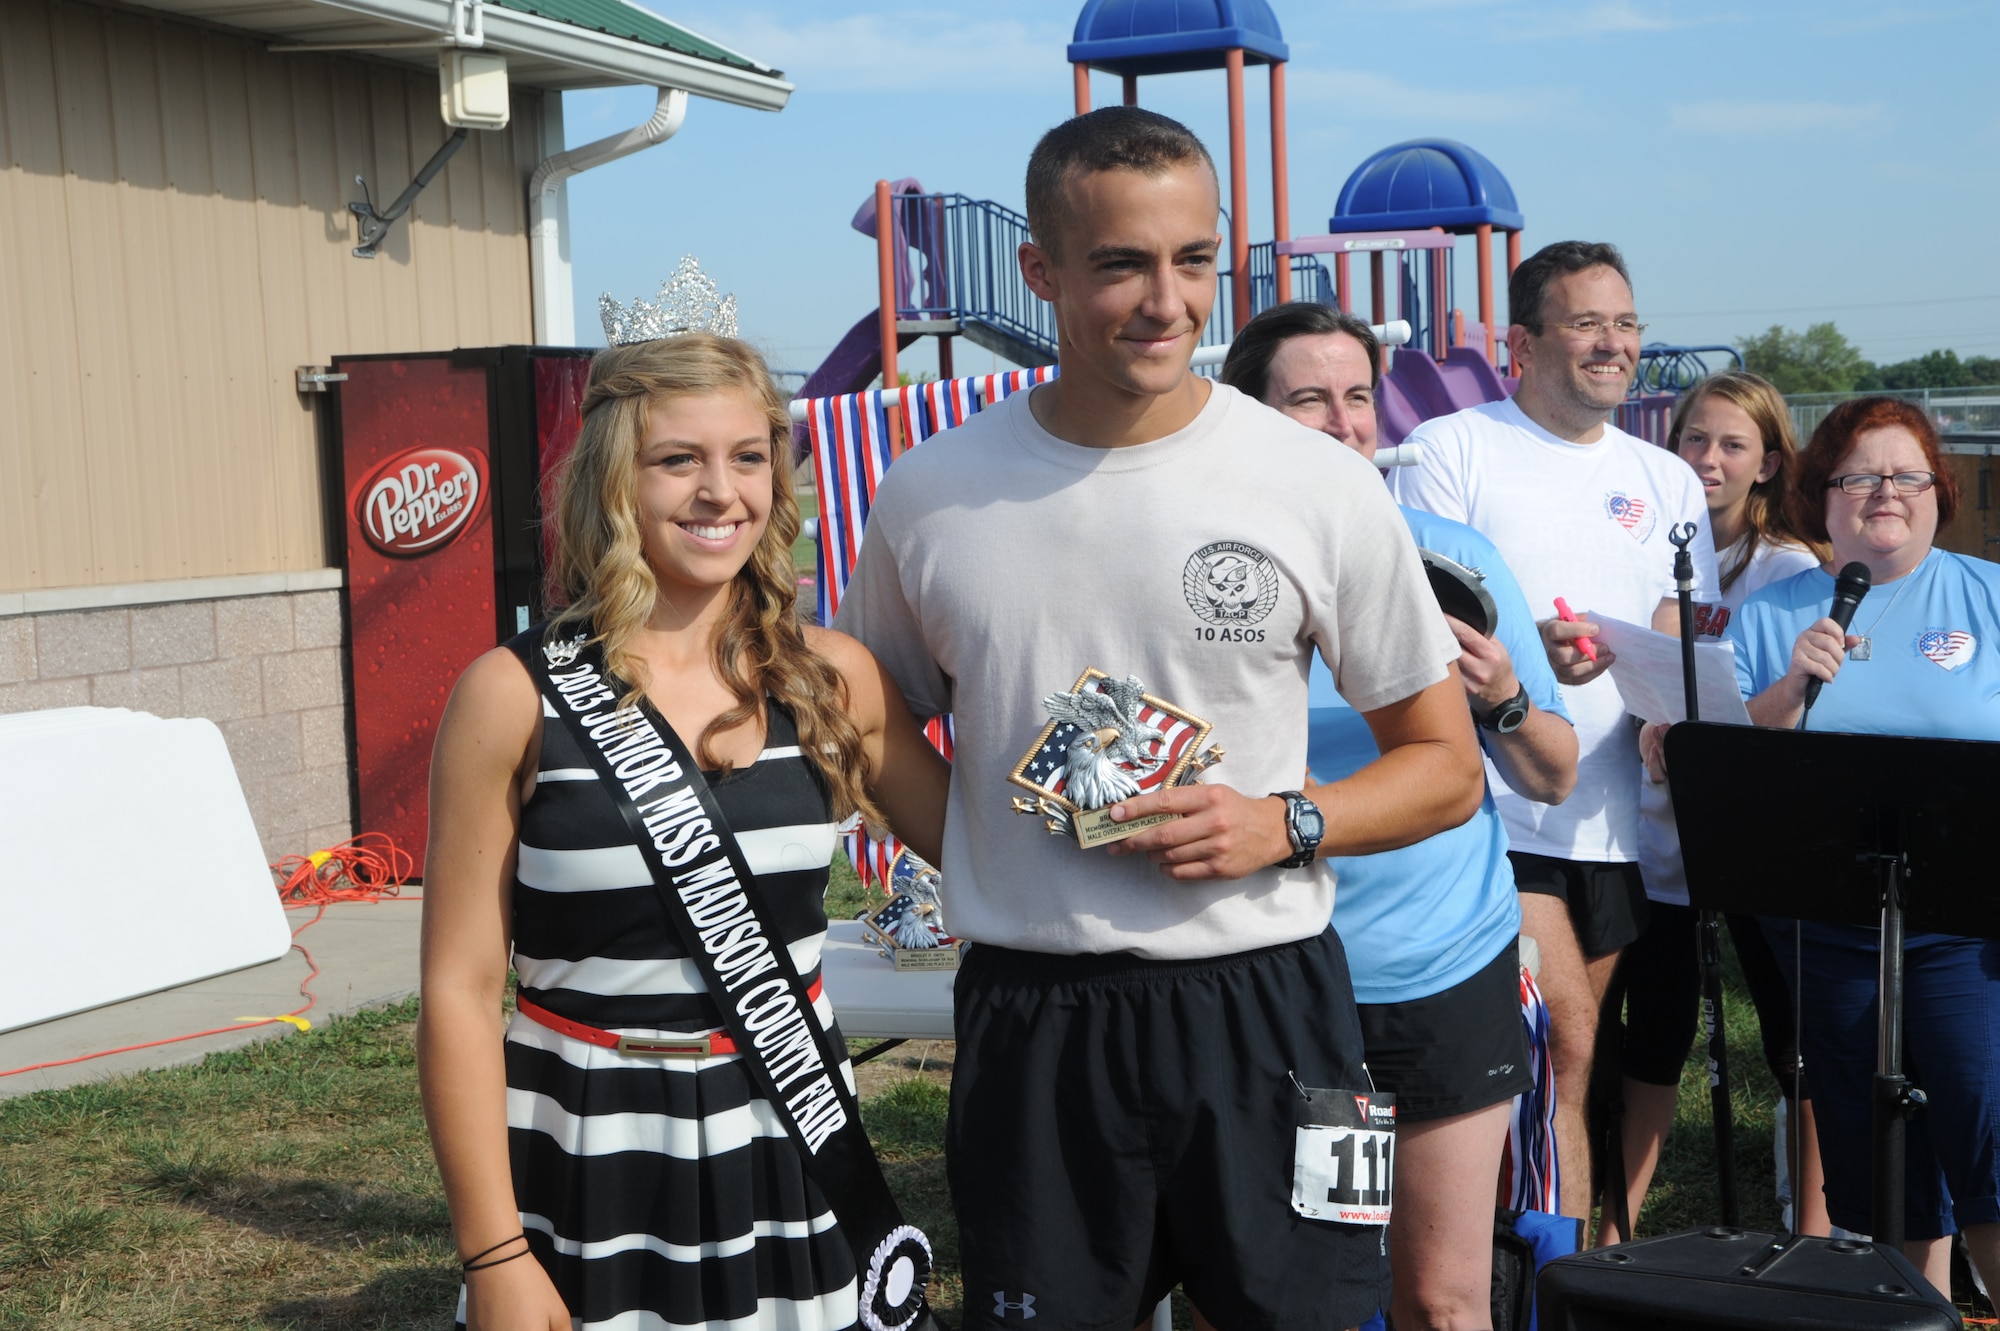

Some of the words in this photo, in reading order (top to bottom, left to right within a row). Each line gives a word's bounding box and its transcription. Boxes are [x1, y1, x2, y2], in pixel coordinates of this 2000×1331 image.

[366, 471, 469, 544] Pepper
[400, 462, 441, 505] Dr
[1200, 545, 1217, 557] U.S.
[1217, 542, 1232, 551] AIR
[1233, 543, 1263, 561] FORCE
[1194, 626, 1216, 641] 10
[1219, 627, 1266, 642] ASOS
[1219, 609, 1246, 619] TACP
[1694, 604, 1731, 638] SA
[549, 663, 616, 712] 2013
[580, 704, 684, 802] JUNIOR
[636, 784, 721, 868] MISS
[1087, 831, 1102, 840] MALE
[1102, 825, 1127, 837] OVERALL
[1127, 822, 1140, 830] 2ND
[1139, 817, 1158, 827] PLACE
[1159, 813, 1174, 822] 2013
[671, 855, 779, 993] MADISON
[735, 977, 825, 1093] COUNTY
[785, 1072, 848, 1156] FAIR
[1328, 1134, 1391, 1206] 111
